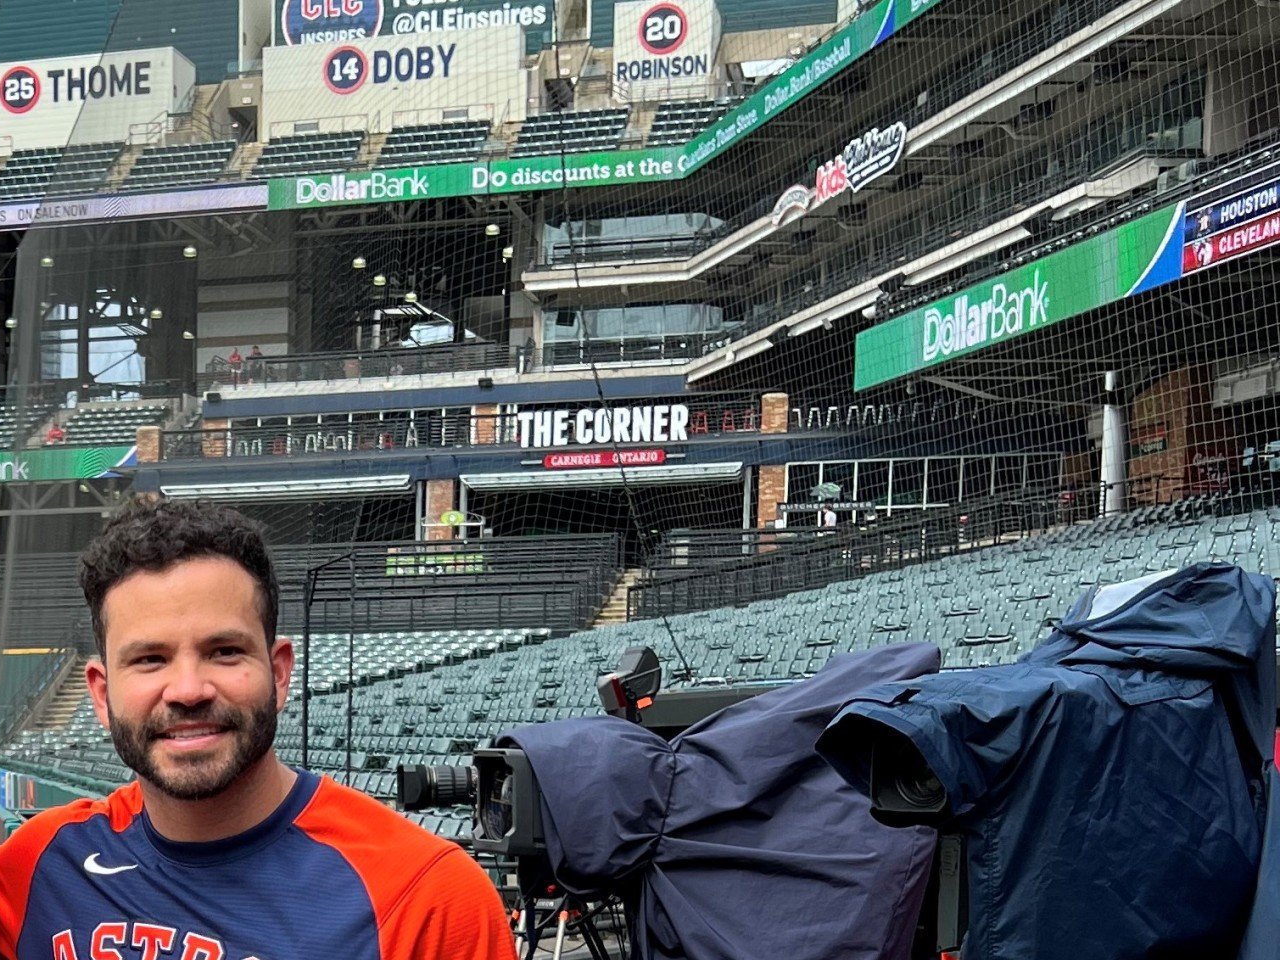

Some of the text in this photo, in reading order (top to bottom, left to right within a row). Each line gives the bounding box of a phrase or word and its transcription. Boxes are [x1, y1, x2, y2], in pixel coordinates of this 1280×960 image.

[646, 15, 681, 42] 20
[4, 60, 151, 103] 25 THOME
[332, 43, 456, 84] 14 DOBY
[616, 53, 708, 82] ROBINSON
[295, 157, 672, 205] DollarBank Do discounts at the
[17, 208, 32, 221] ON
[33, 206, 61, 220] SALE
[62, 203, 89, 218] NOW
[1220, 186, 1278, 223] HOUSTON
[1219, 216, 1280, 254] CLEVELAN
[922, 267, 1050, 362] DollarBank
[517, 403, 689, 448] THE CORNER
[550, 451, 658, 467] CARNEGIE ONTARIO
